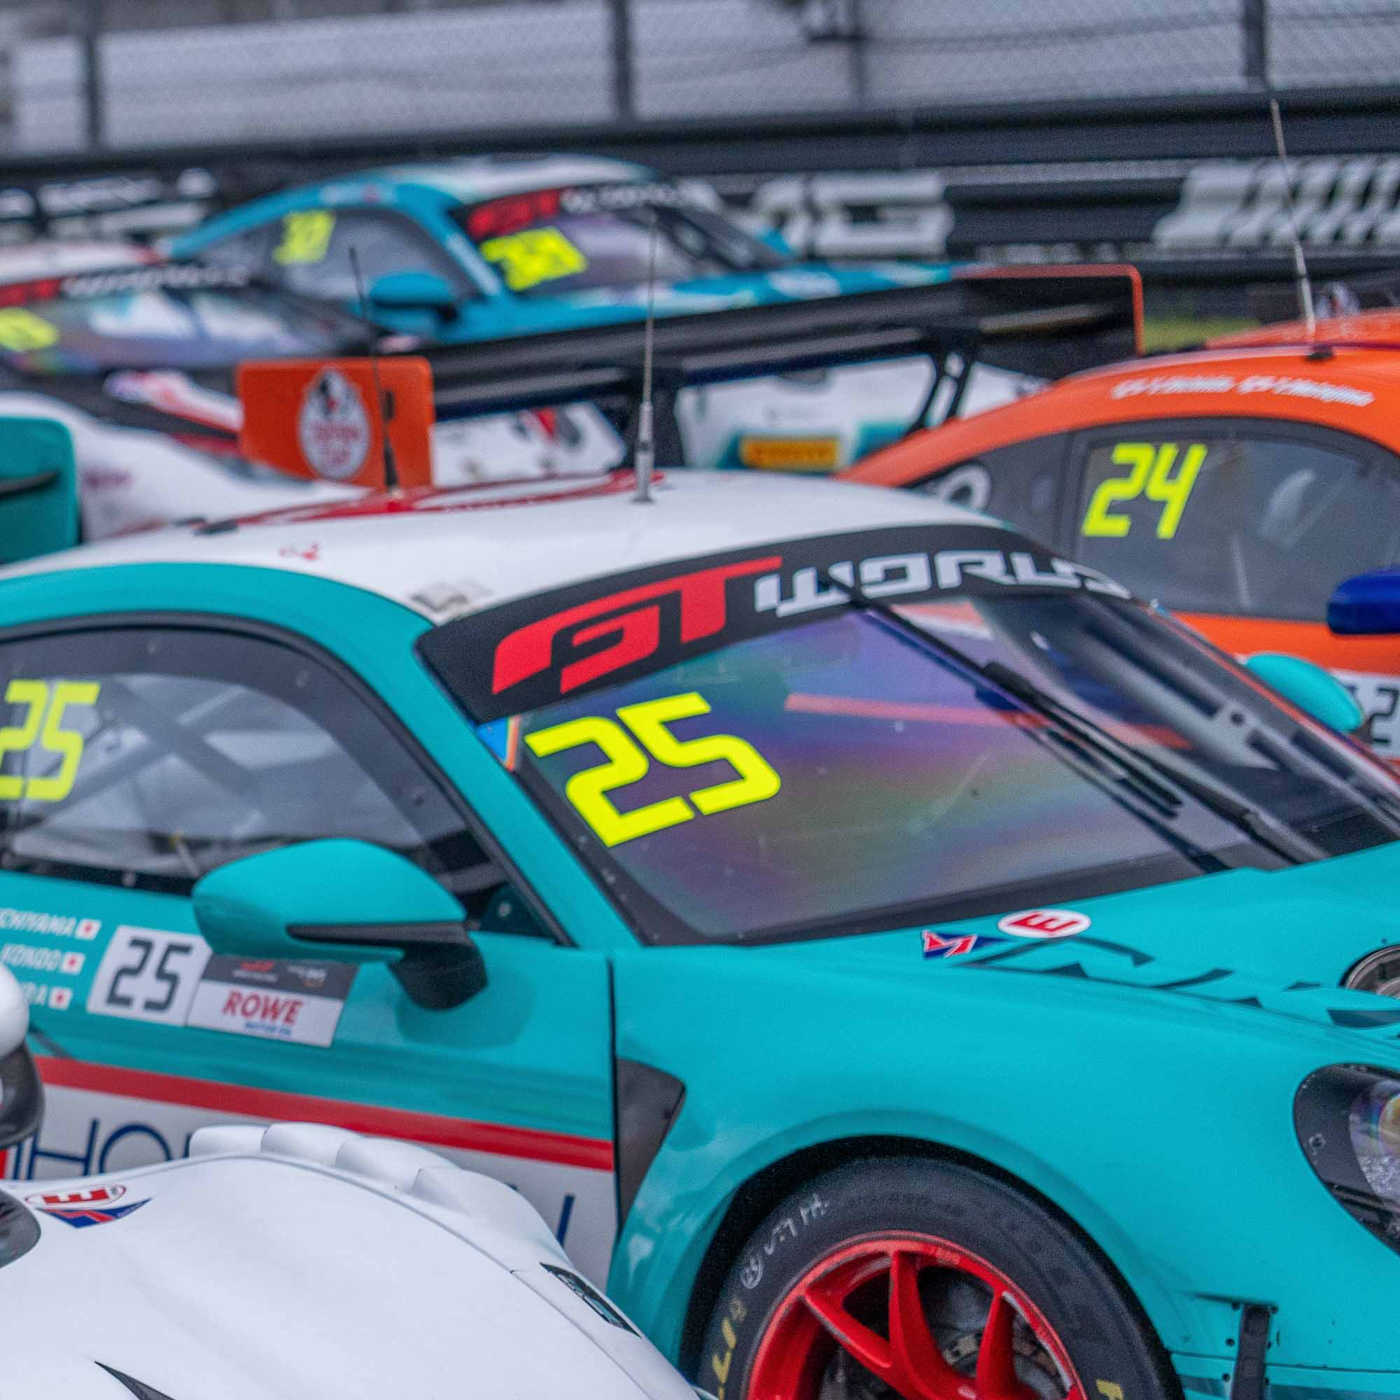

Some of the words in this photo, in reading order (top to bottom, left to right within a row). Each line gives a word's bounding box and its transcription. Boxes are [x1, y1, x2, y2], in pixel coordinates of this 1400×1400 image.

[1082, 442, 1207, 540] 24
[491, 556, 784, 696] GT
[524, 692, 783, 848] 25
[105, 936, 193, 1013] 25
[222, 989, 304, 1026] ROWE
